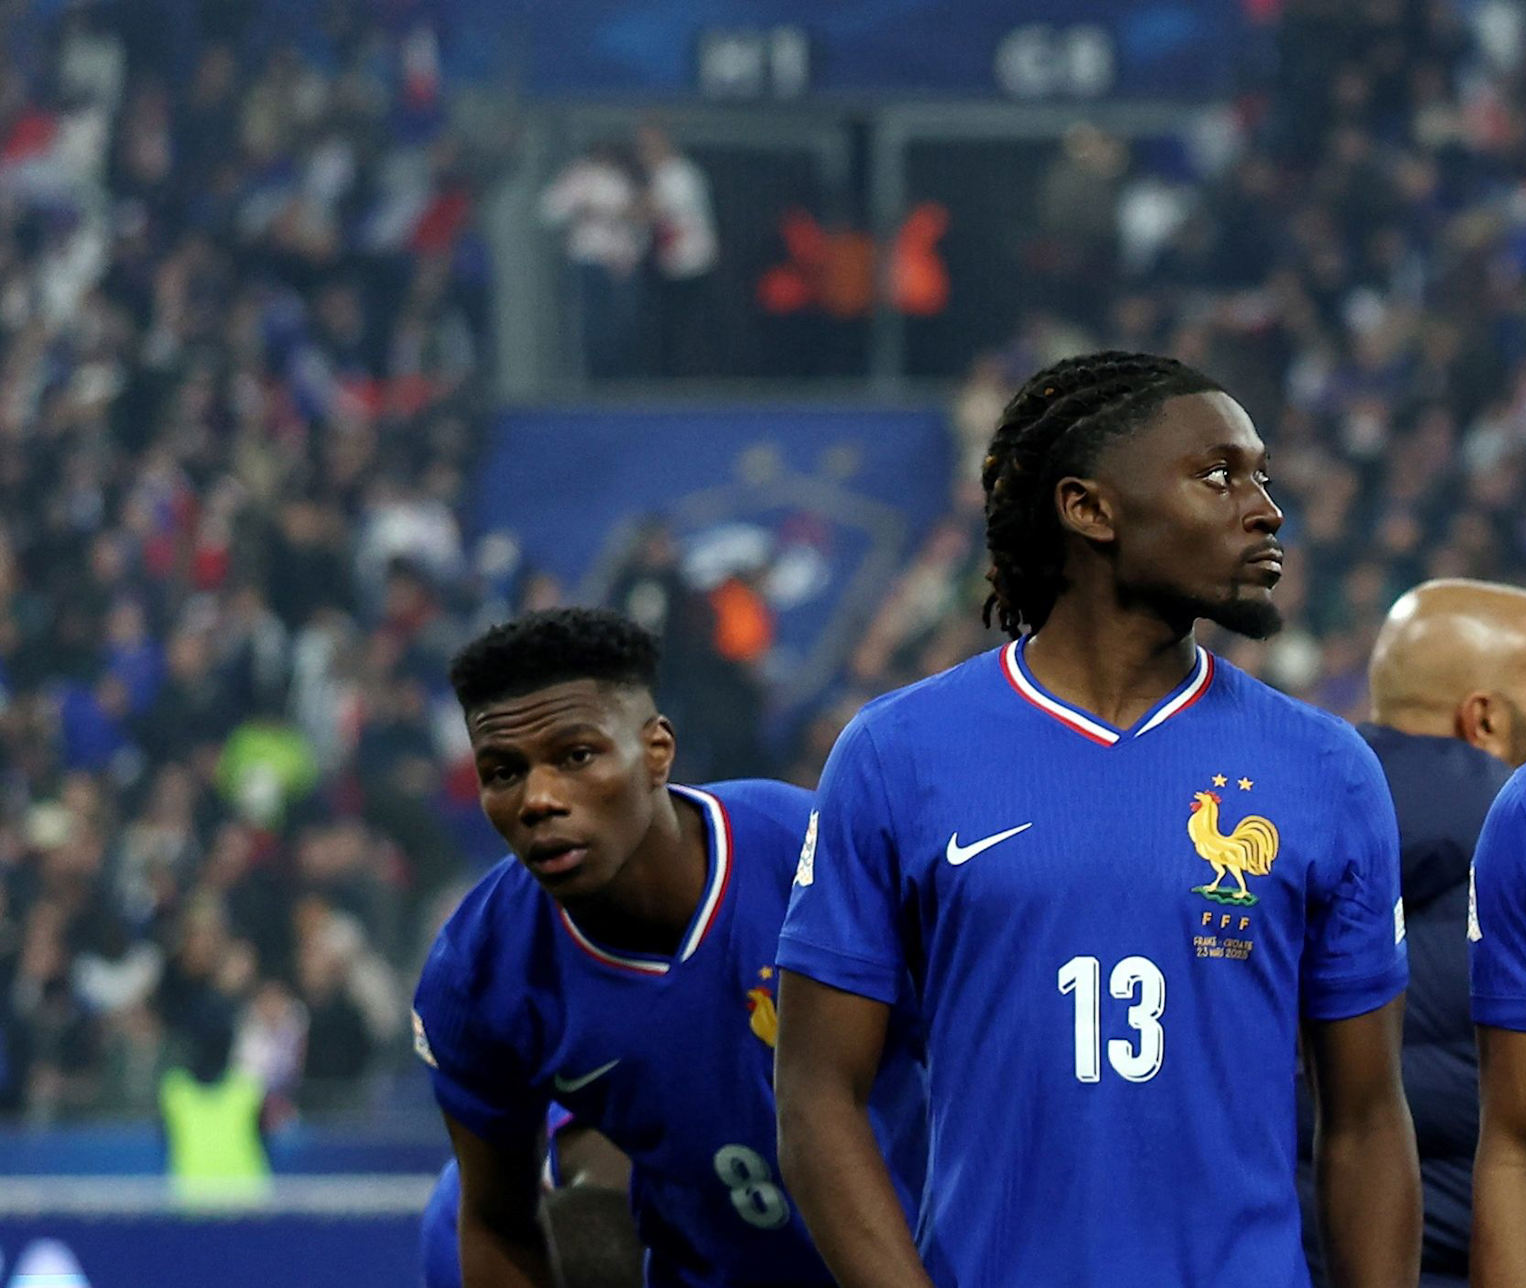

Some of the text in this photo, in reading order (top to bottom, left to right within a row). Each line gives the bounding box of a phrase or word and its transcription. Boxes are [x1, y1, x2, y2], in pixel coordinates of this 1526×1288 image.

[1196, 946, 1208, 957] 23
[1056, 955, 1166, 1084] 13
[712, 1143, 791, 1230] 8
